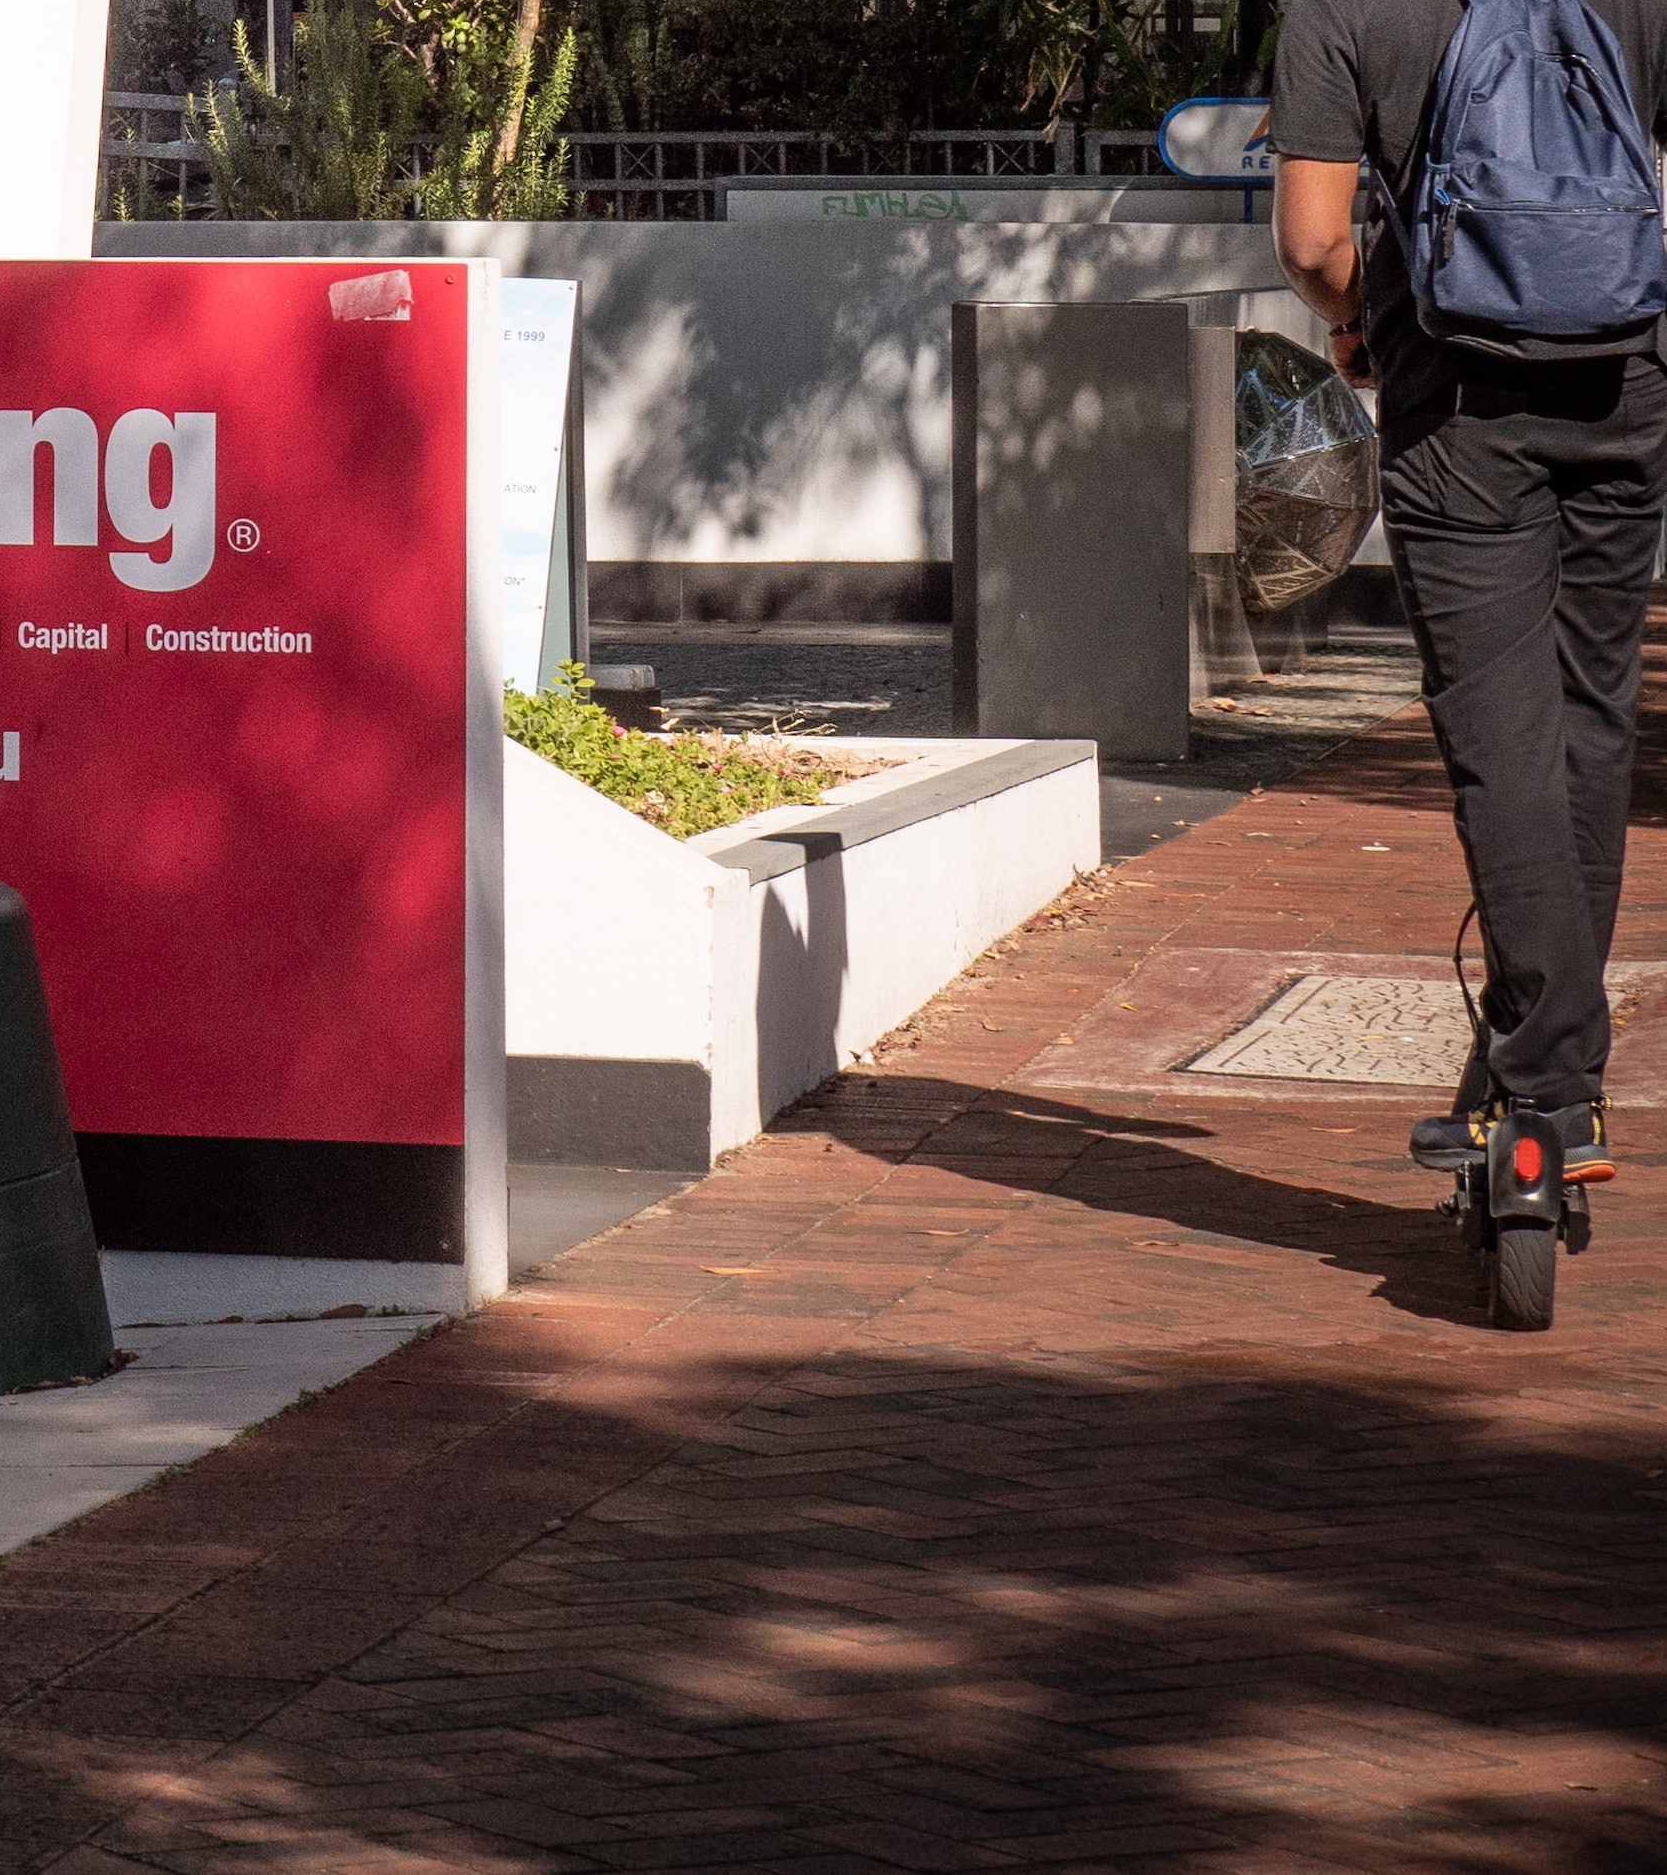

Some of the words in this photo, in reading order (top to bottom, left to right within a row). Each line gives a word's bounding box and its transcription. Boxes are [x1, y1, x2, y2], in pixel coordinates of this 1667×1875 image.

[517, 330, 546, 342] 1999
[17, 622, 109, 655] Capital
[145, 623, 313, 654] Construction
